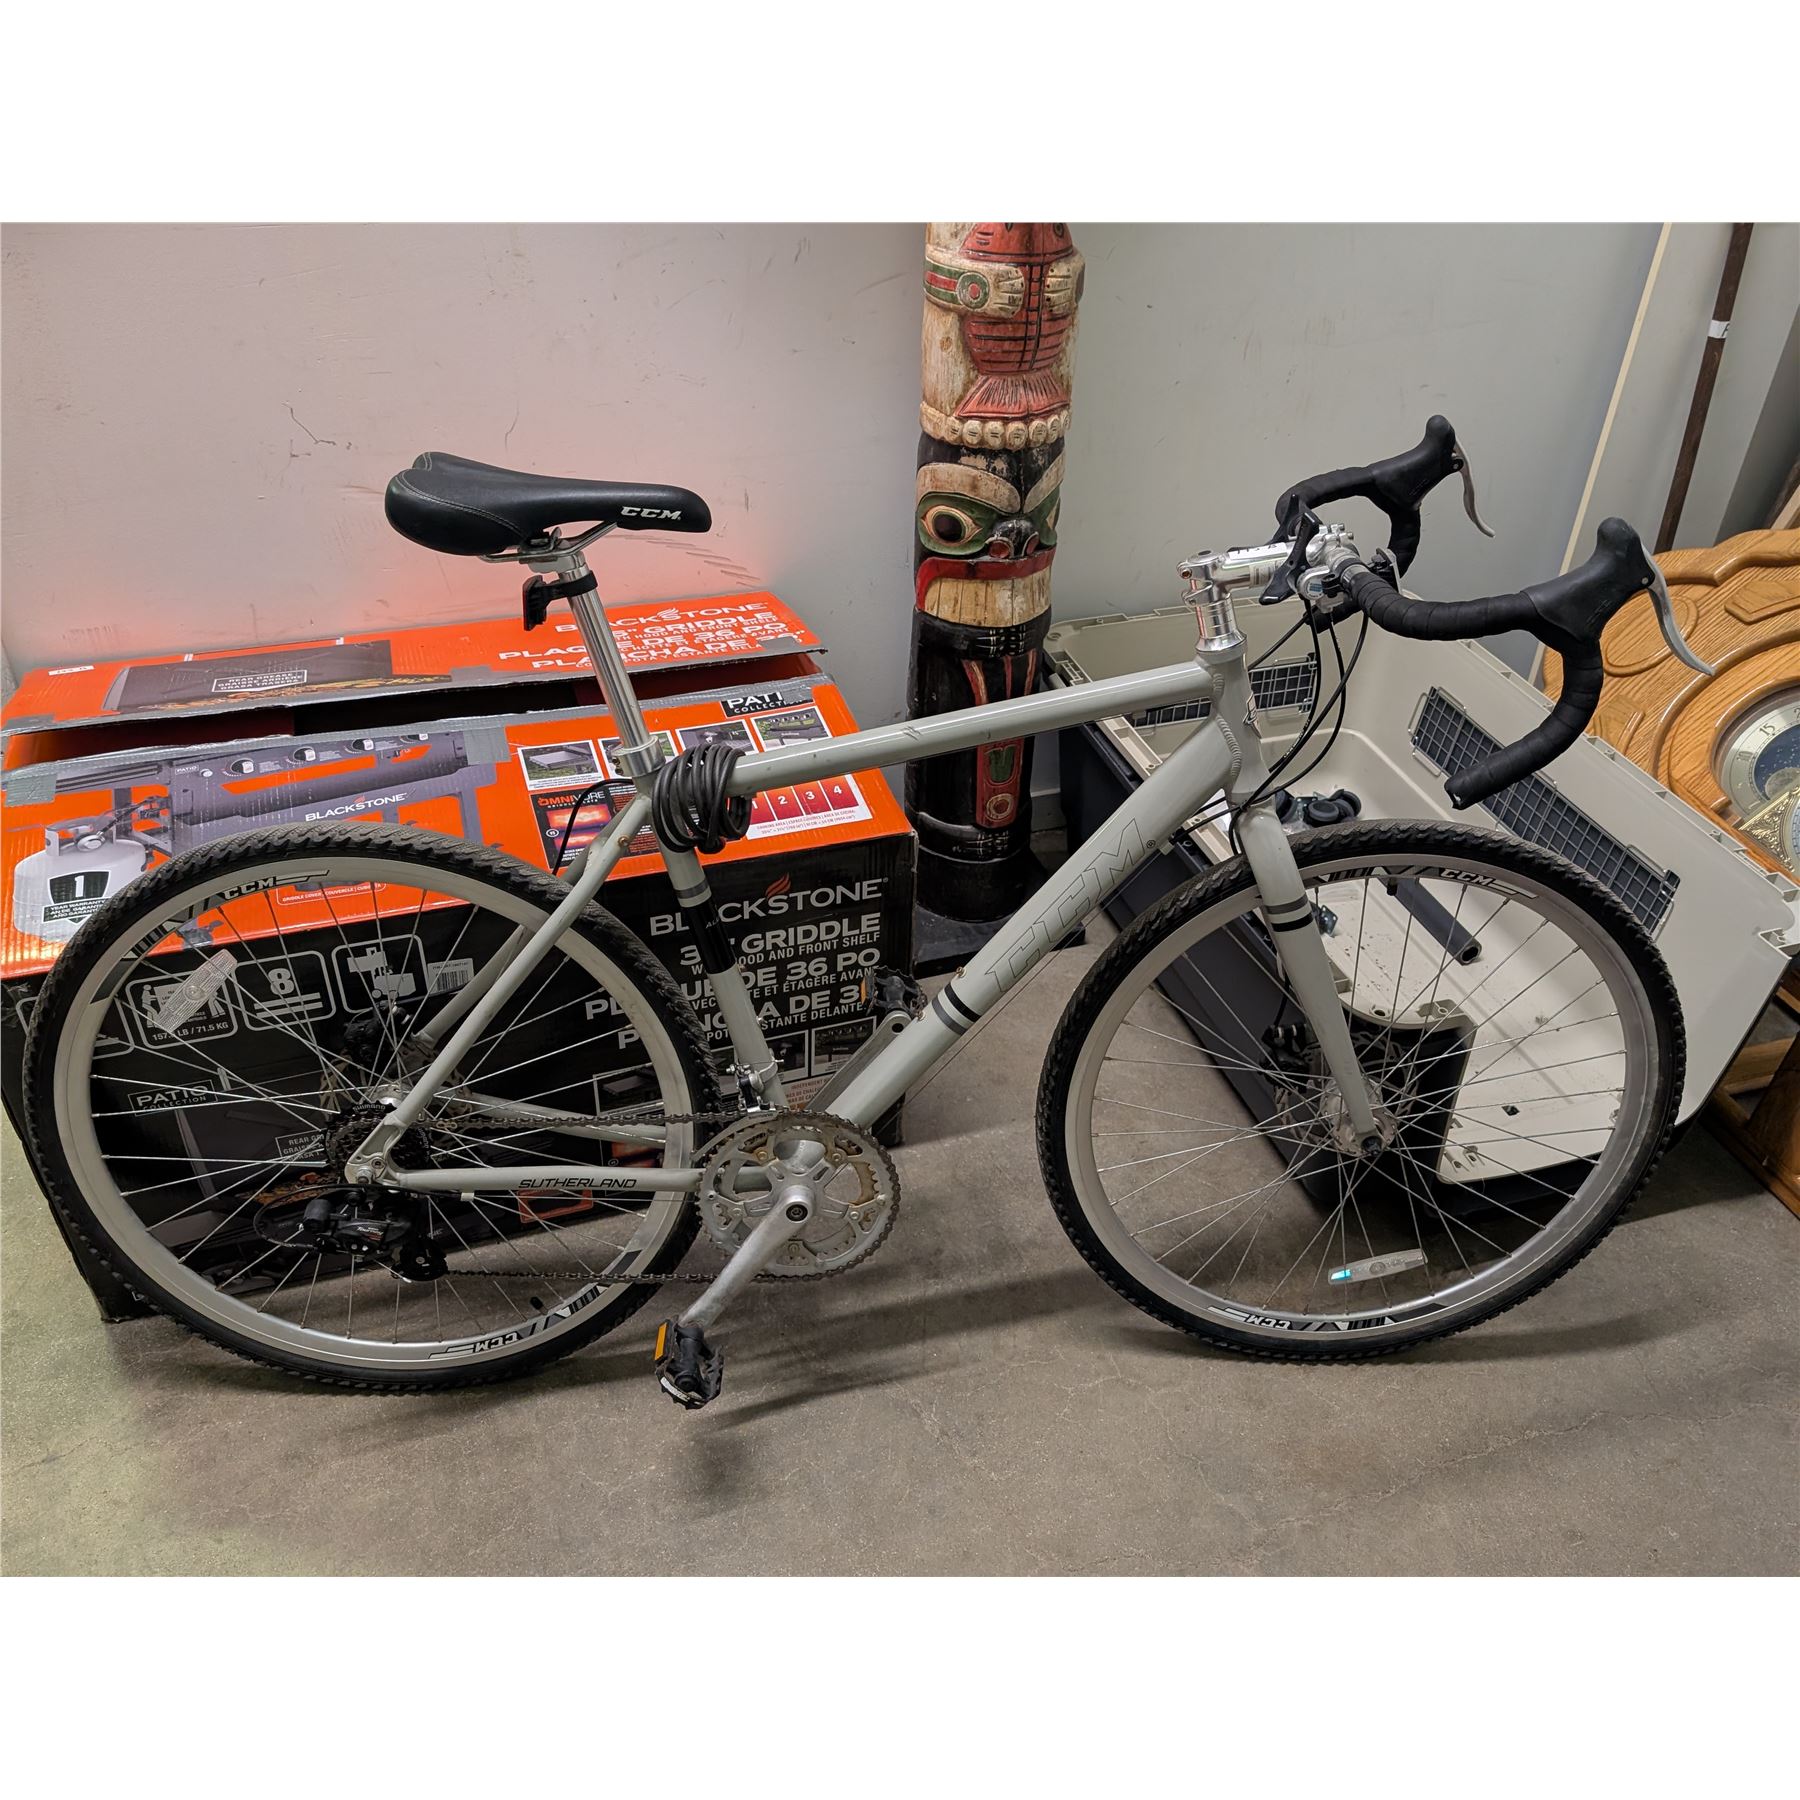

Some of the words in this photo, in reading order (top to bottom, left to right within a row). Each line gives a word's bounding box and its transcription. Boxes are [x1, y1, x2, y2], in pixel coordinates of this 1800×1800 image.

[621, 506, 681, 520] CCM
[555, 602, 768, 632] BCKSTONE
[643, 611, 773, 633] GRIDDLE
[701, 623, 738, 631] FRONT
[499, 641, 632, 660] PLAQE
[642, 635, 684, 646] DE
[693, 629, 735, 639] 36
[742, 622, 786, 634] PO
[704, 639, 748, 651] DE
[727, 691, 783, 709] PATI
[1759, 722, 1776, 736] 15
[777, 796, 788, 804] 2
[805, 791, 815, 800] 3
[833, 785, 842, 794] 4
[304, 792, 407, 822] BLACKSTONE
[75, 875, 84, 897] 1
[1440, 868, 1495, 886] CCM
[223, 877, 275, 899] CCM
[650, 878, 883, 936] BLCKSTONE
[984, 818, 1146, 993] CCM
[741, 912, 881, 954] GRIDDLE
[738, 952, 765, 965] OOD
[768, 947, 795, 961] AND
[798, 939, 839, 955] FRONT
[842, 932, 881, 948] SHELF
[741, 966, 777, 989] DE
[786, 957, 828, 981] 36
[836, 947, 881, 972] PO
[268, 967, 295, 995] 8
[692, 997, 717, 1010] VEC
[764, 984, 779, 997] ET
[840, 966, 872, 982] AVAN
[789, 989, 831, 1014] DE
[177, 1028, 189, 1037] LB
[196, 1024, 215, 1033] 71.5
[216, 1021, 229, 1030] KG
[761, 1013, 807, 1031] STANTE
[136, 1085, 208, 1106] PATIO
[288, 1136, 309, 1145] REAR
[518, 1177, 637, 1188] SUTHERLAND
[1246, 1315, 1291, 1330] CCM
[475, 1332, 518, 1353] CCM
